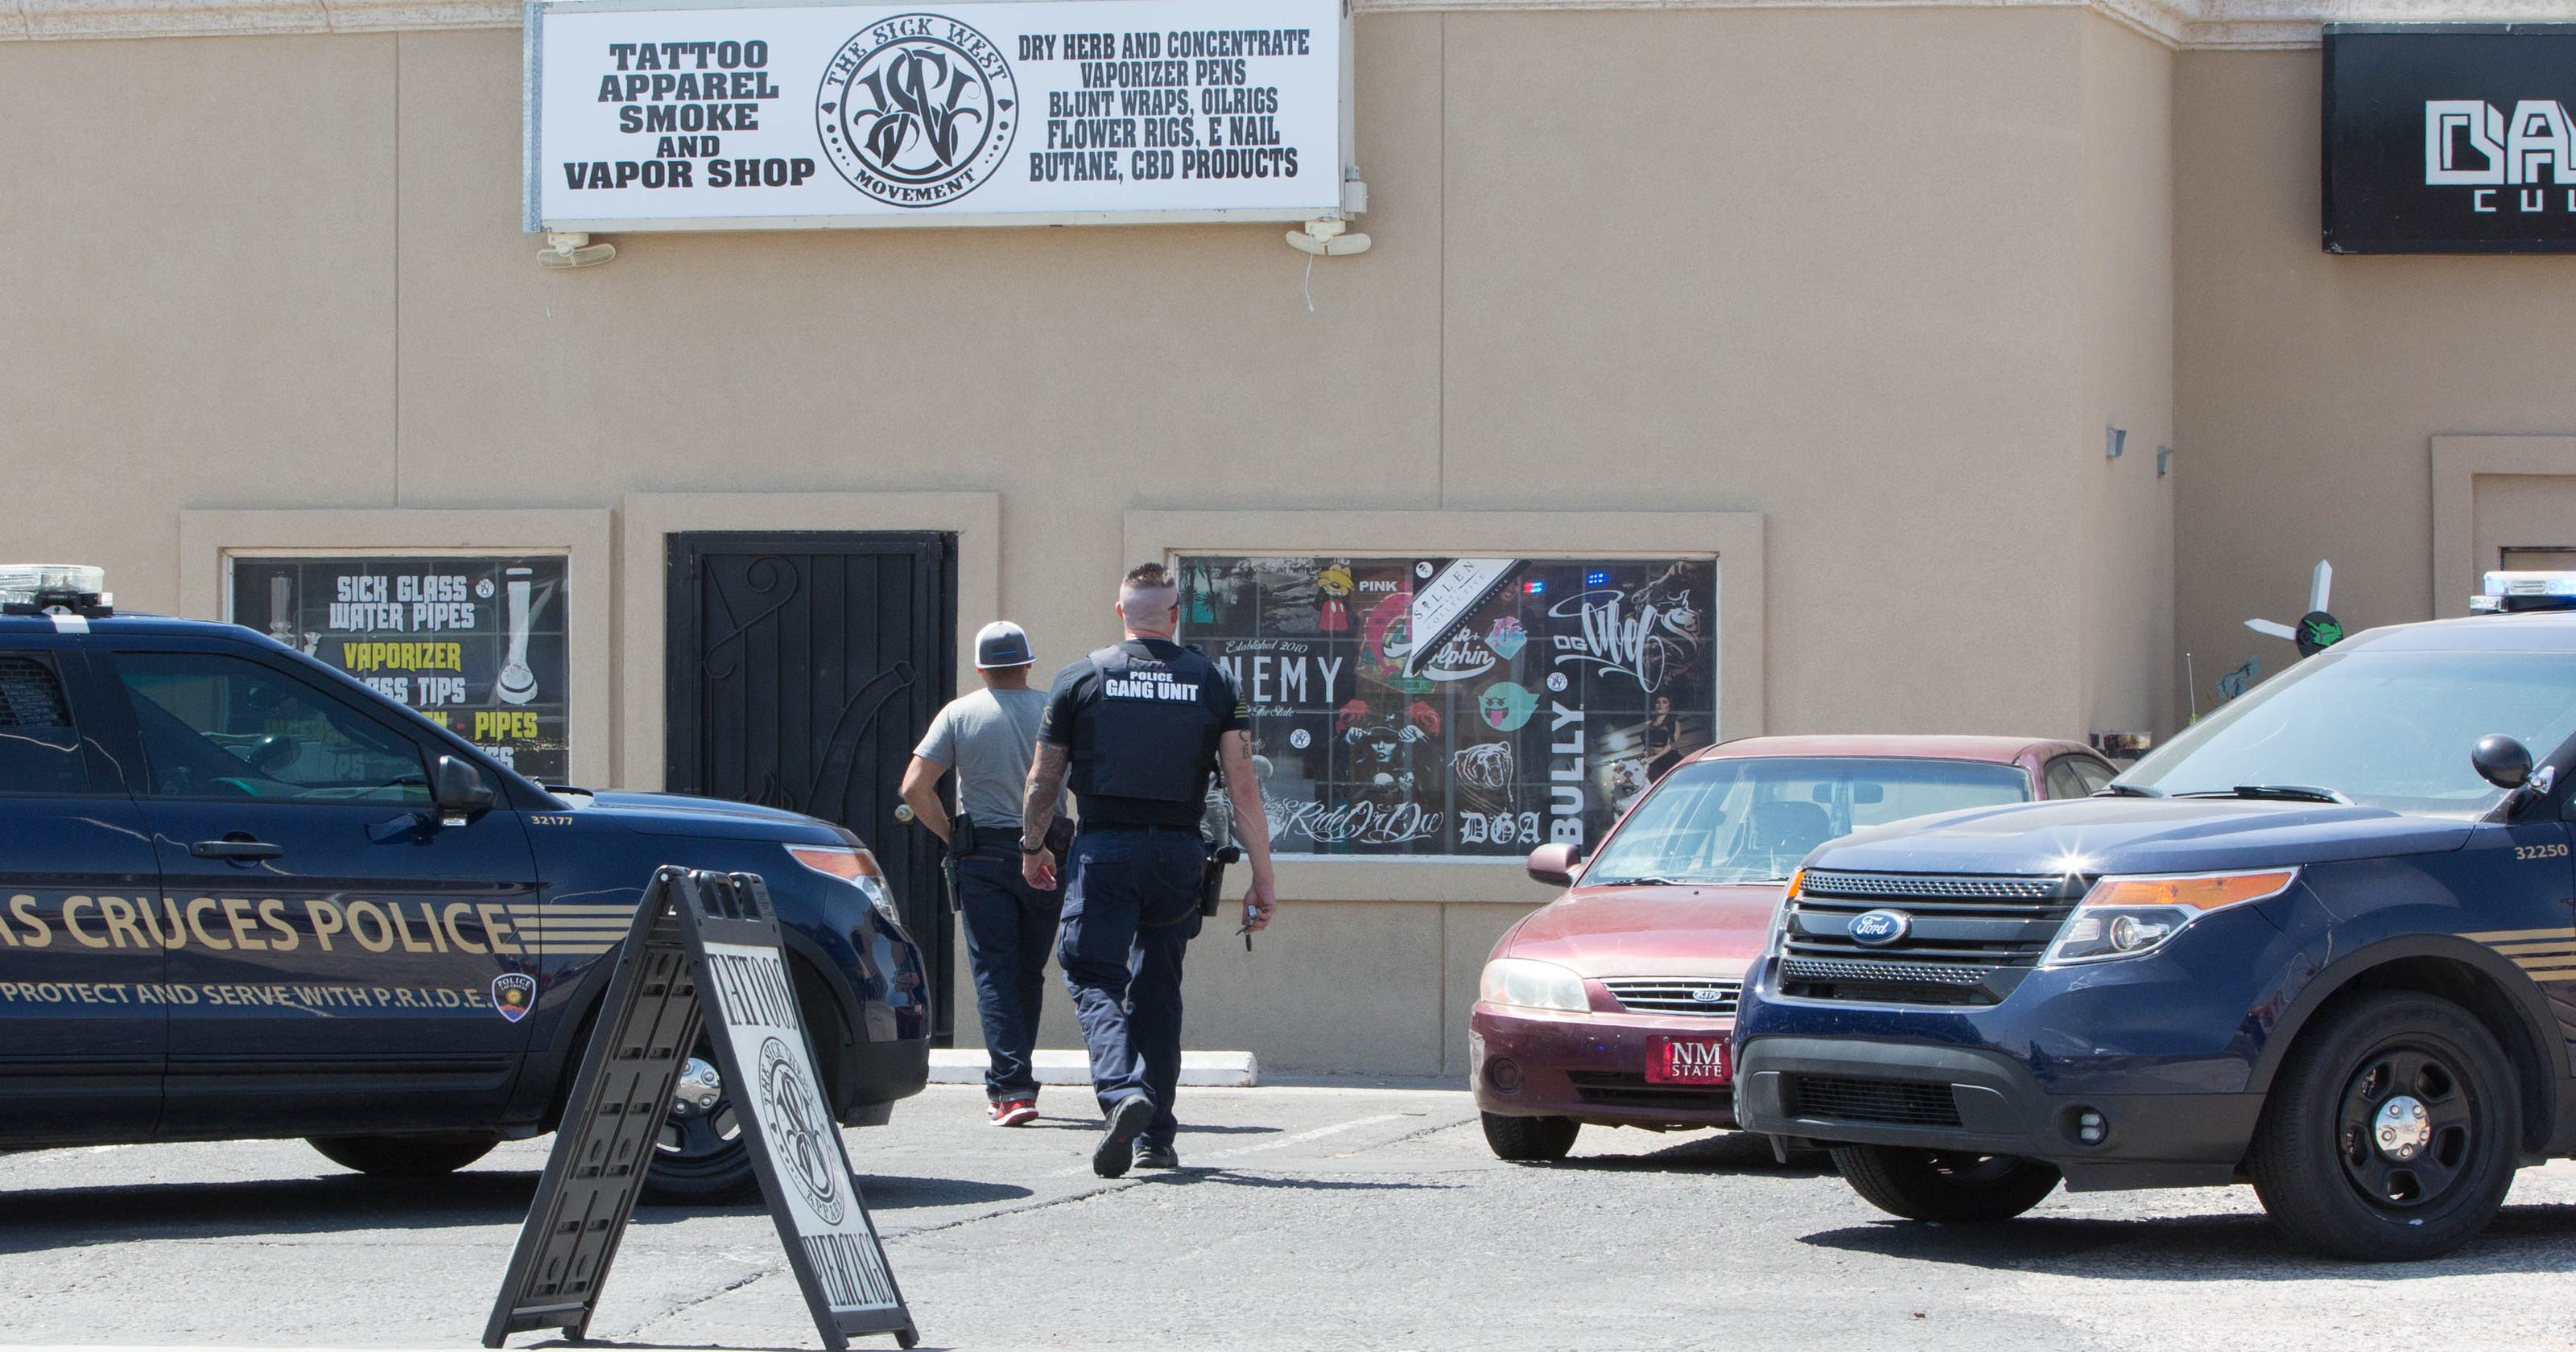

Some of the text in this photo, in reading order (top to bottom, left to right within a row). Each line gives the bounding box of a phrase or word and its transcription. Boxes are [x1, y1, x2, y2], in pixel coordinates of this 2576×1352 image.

[609, 40, 768, 71] TATTOO
[827, 18, 1008, 87] THE SICK WEST
[1018, 29, 1310, 61] DRY HERB AND CONCENTRATE
[598, 72, 778, 102] APPAREL
[1080, 59, 1246, 89] VAPORIZER PENS
[1049, 87, 1278, 118] BLUNT WRAPS, OILRIGS
[620, 103, 758, 134] SMOKE
[1047, 116, 1280, 150] FLOWER RIGS, E NAIL
[656, 136, 720, 159] AND
[564, 159, 815, 190] VAPOR SHOP
[1030, 147, 1298, 185] BUTANE, CBD PRODUCTS
[853, 168, 976, 202] MOVEMENT
[337, 575, 387, 604] SICK
[397, 575, 467, 604] GLASS
[1359, 581, 1397, 592] PINK
[329, 603, 475, 632] WATER PIPES
[343, 642, 461, 672] VAPORIZER
[1226, 639, 1308, 653] Established 2010
[1427, 642, 1496, 670] lphin
[1553, 635, 1588, 651] OG
[1106, 679, 1198, 701] GANG UNIT
[1130, 671, 1173, 682] POLICE
[1220, 656, 1343, 703] NEMY
[417, 677, 466, 707] TIPS
[474, 711, 538, 741] PIPES
[1253, 705, 1269, 716] The
[1270, 705, 1294, 717] State
[1551, 701, 1584, 846] BULLY
[530, 816, 573, 825] 32177
[1460, 810, 1542, 845] DGA
[2515, 843, 2568, 860] 32250
[63, 896, 299, 951] CRUCES
[304, 900, 522, 954] POLICE
[1857, 916, 1889, 934] Ford
[0, 983, 493, 1008] PROTECT AND SERVE WITH P.R.I.D.E.
[497, 977, 531, 987] POLICE
[708, 954, 796, 1029] TATTOOS
[765, 1044, 784, 1066] SICK
[1672, 1043, 1722, 1065] NM
[761, 1063, 772, 1106] THE
[1672, 1065, 1722, 1077] STATE
[801, 1233, 893, 1305] PIERCINGS
